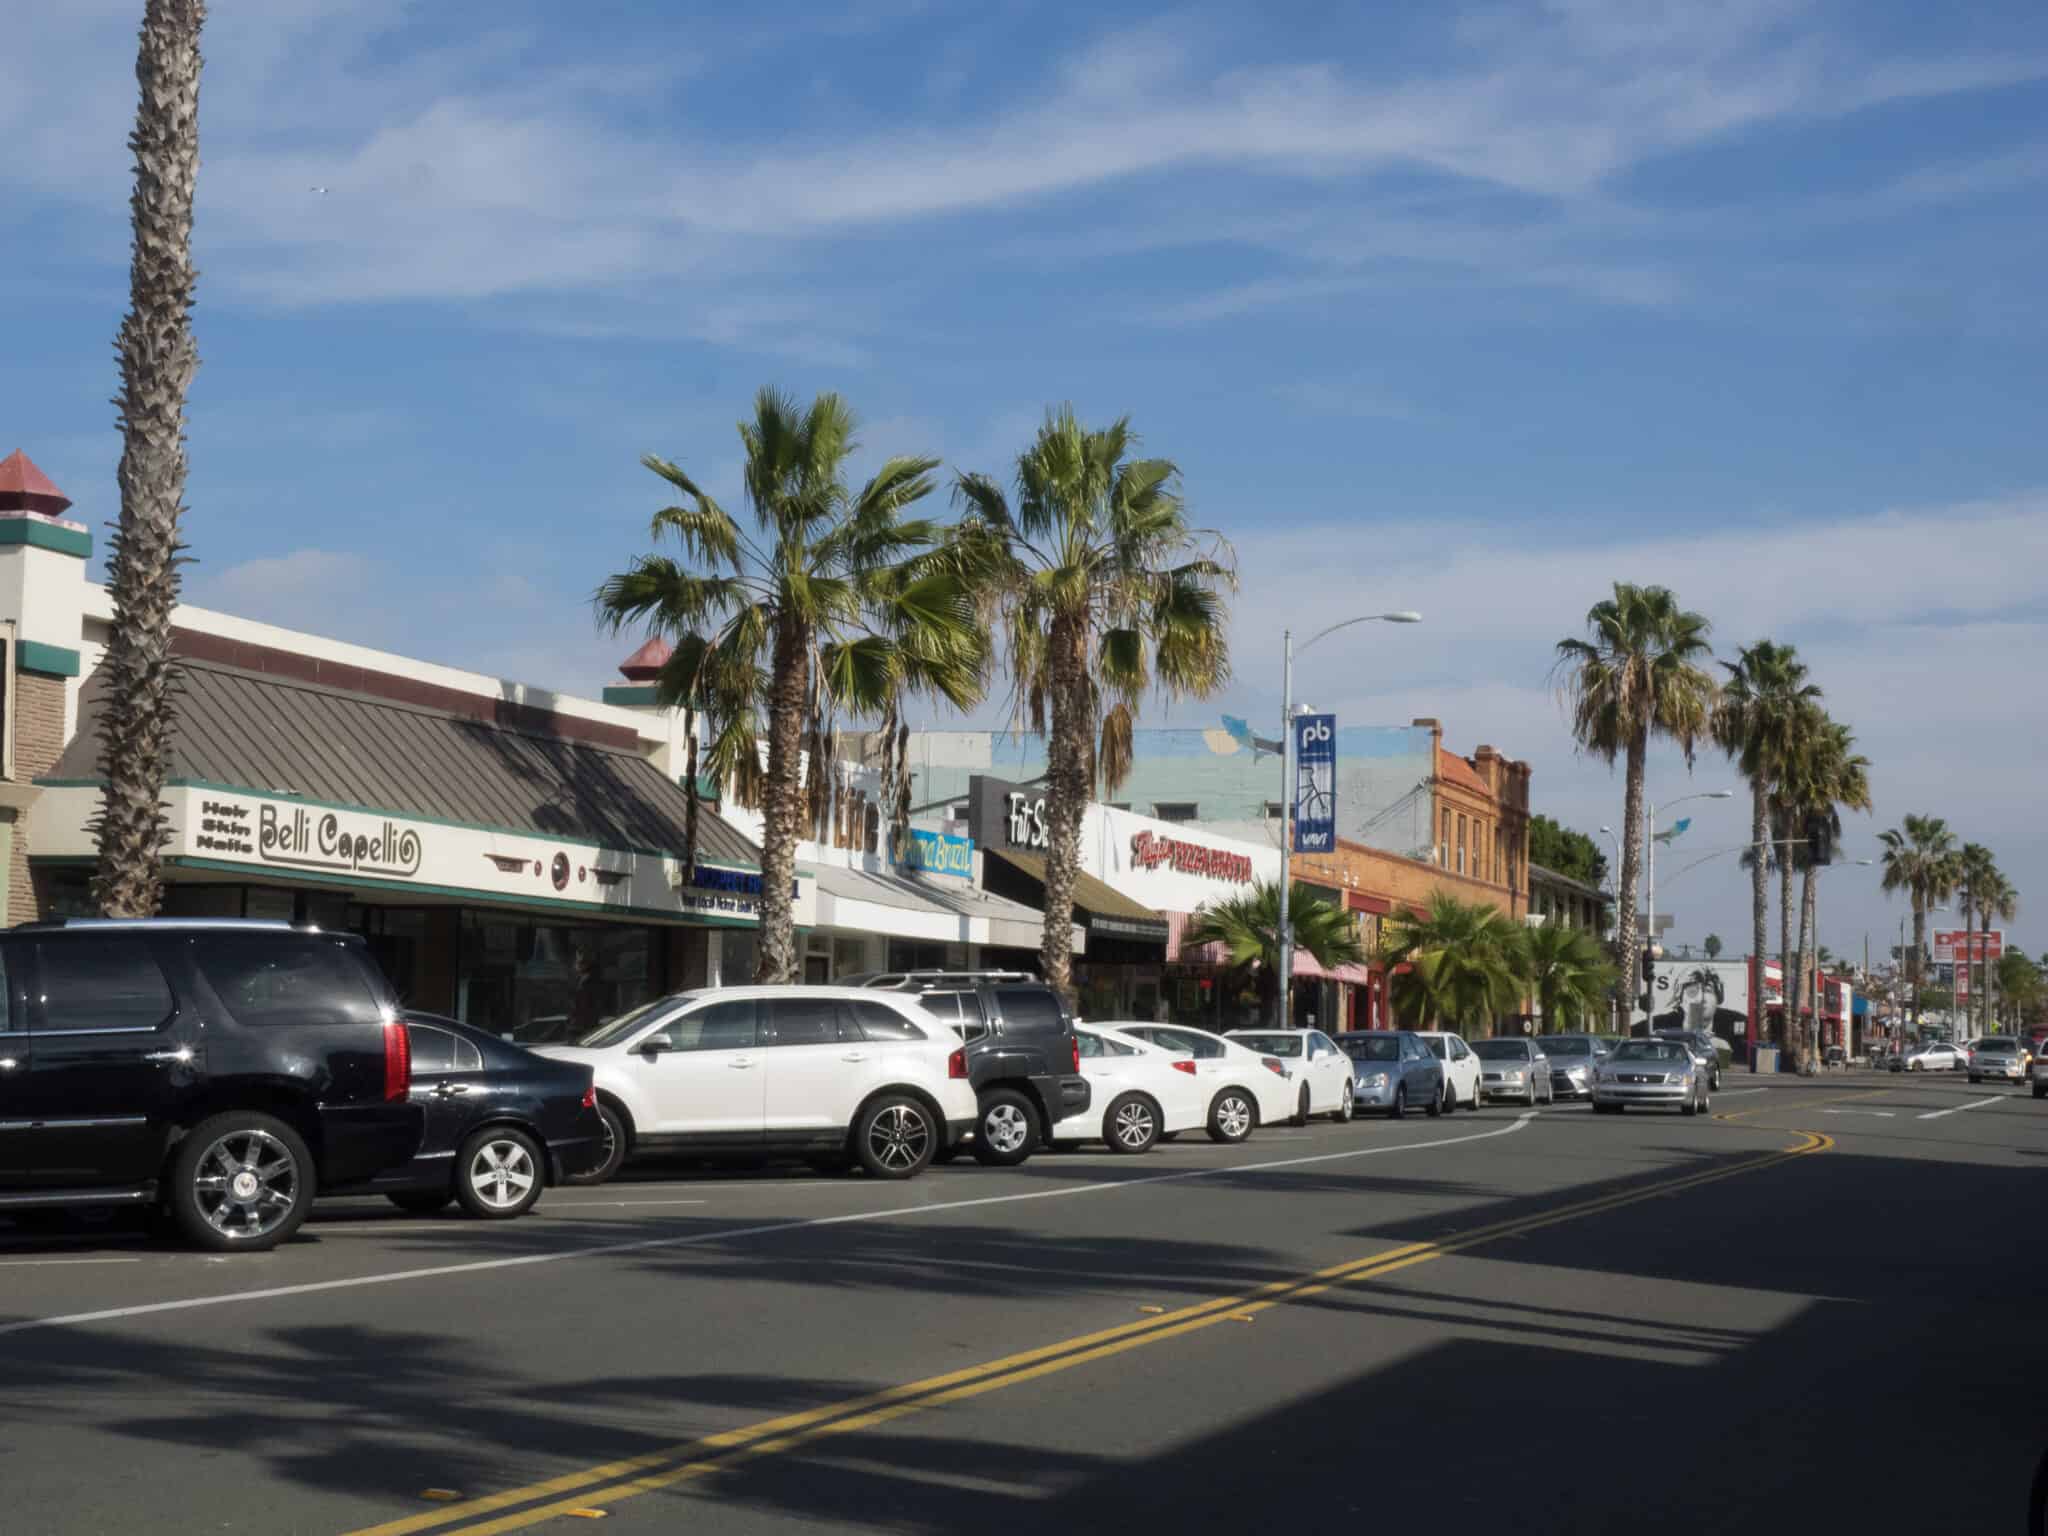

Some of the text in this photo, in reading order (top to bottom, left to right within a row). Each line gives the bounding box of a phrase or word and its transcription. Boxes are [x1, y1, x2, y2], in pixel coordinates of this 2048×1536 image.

[1303, 720, 1330, 748] pb
[202, 801, 250, 818] Hair
[1010, 792, 1033, 844] Fat
[202, 819, 251, 836] Skin
[260, 804, 310, 853] Belli
[197, 835, 253, 853] Nails
